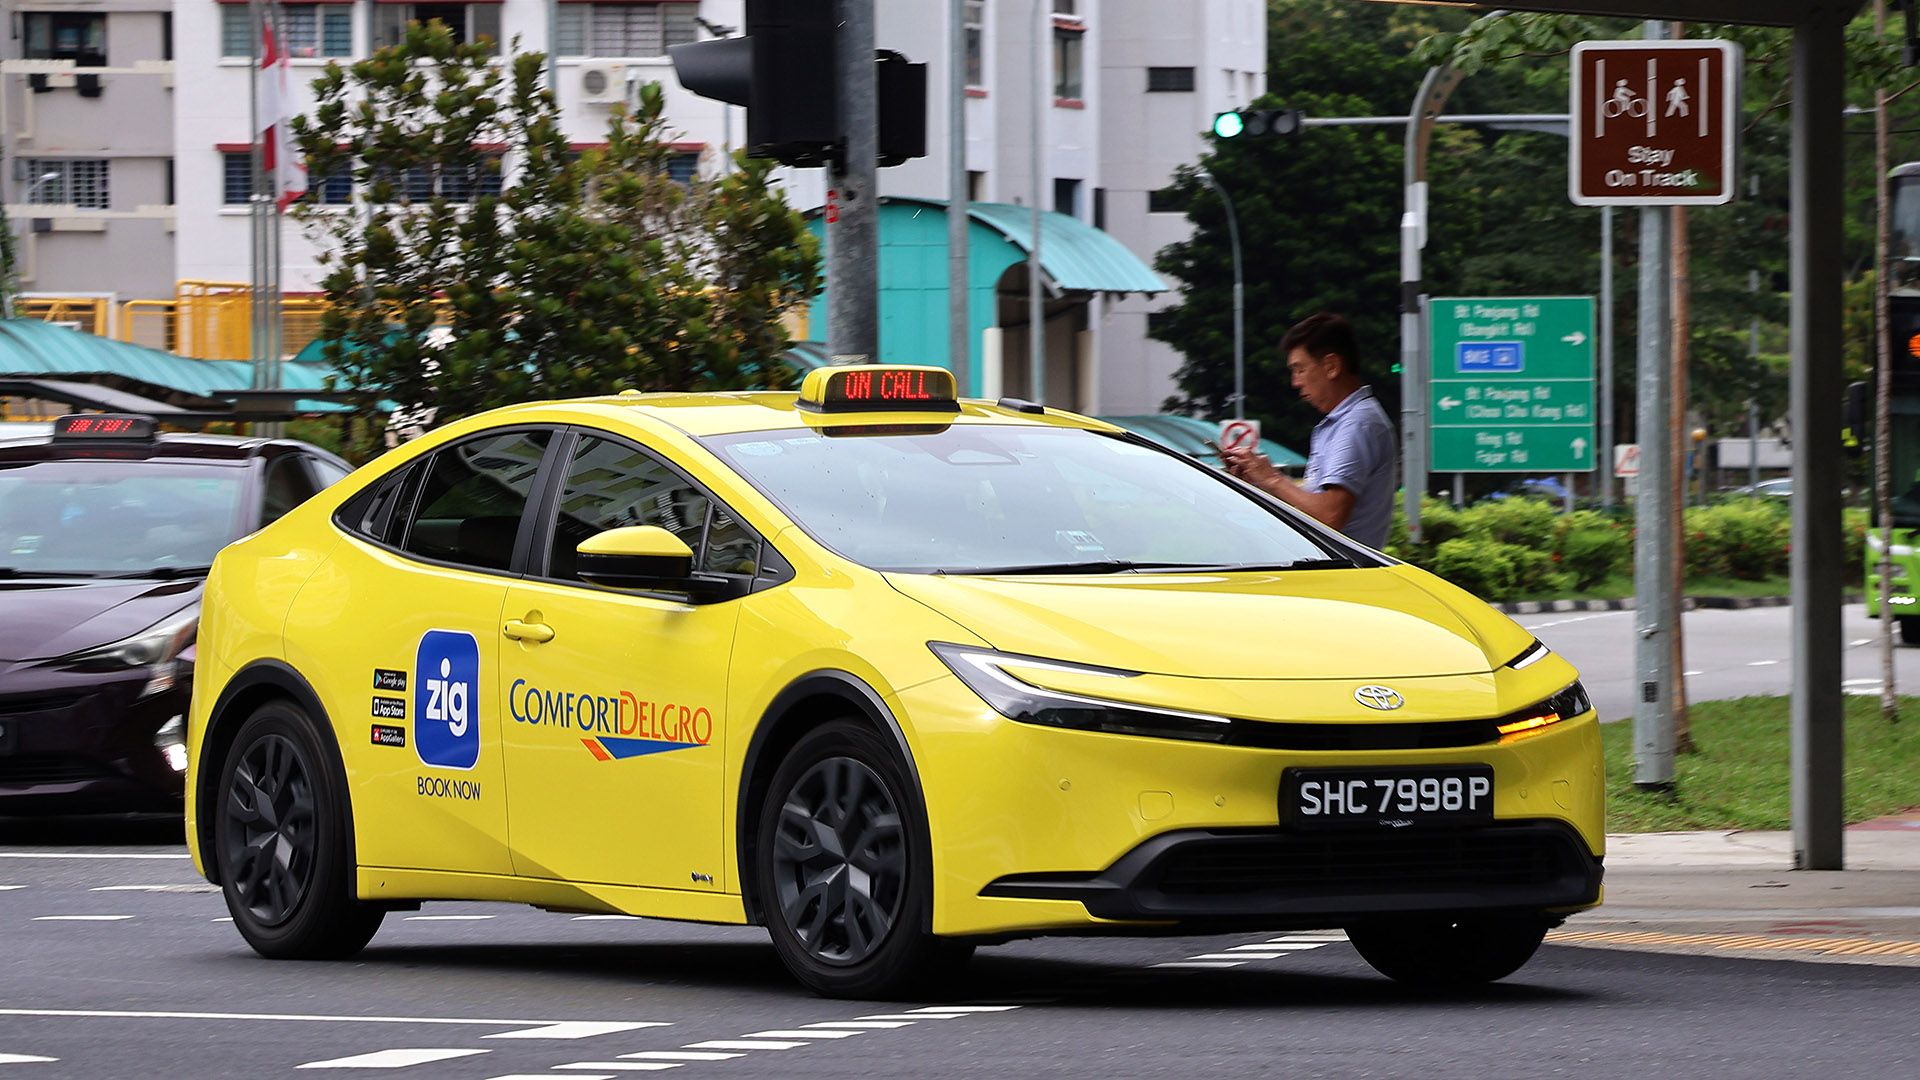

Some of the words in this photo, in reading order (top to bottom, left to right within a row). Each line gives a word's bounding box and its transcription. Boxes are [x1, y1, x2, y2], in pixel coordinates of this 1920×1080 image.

[1627, 145, 1676, 167] Stay
[1604, 169, 1637, 187] On
[1638, 168, 1699, 187] Track
[845, 371, 872, 399] ON
[880, 370, 931, 399] CALL
[426, 657, 468, 737] zig
[380, 705, 391, 717] App
[391, 706, 404, 717] Store
[509, 678, 712, 745] COMFORTDELGRO
[417, 776, 452, 798] BOOK
[453, 780, 481, 801] NOW
[1300, 780, 1368, 815] SHC
[1373, 777, 1463, 813] 7998
[1468, 776, 1490, 811] P
